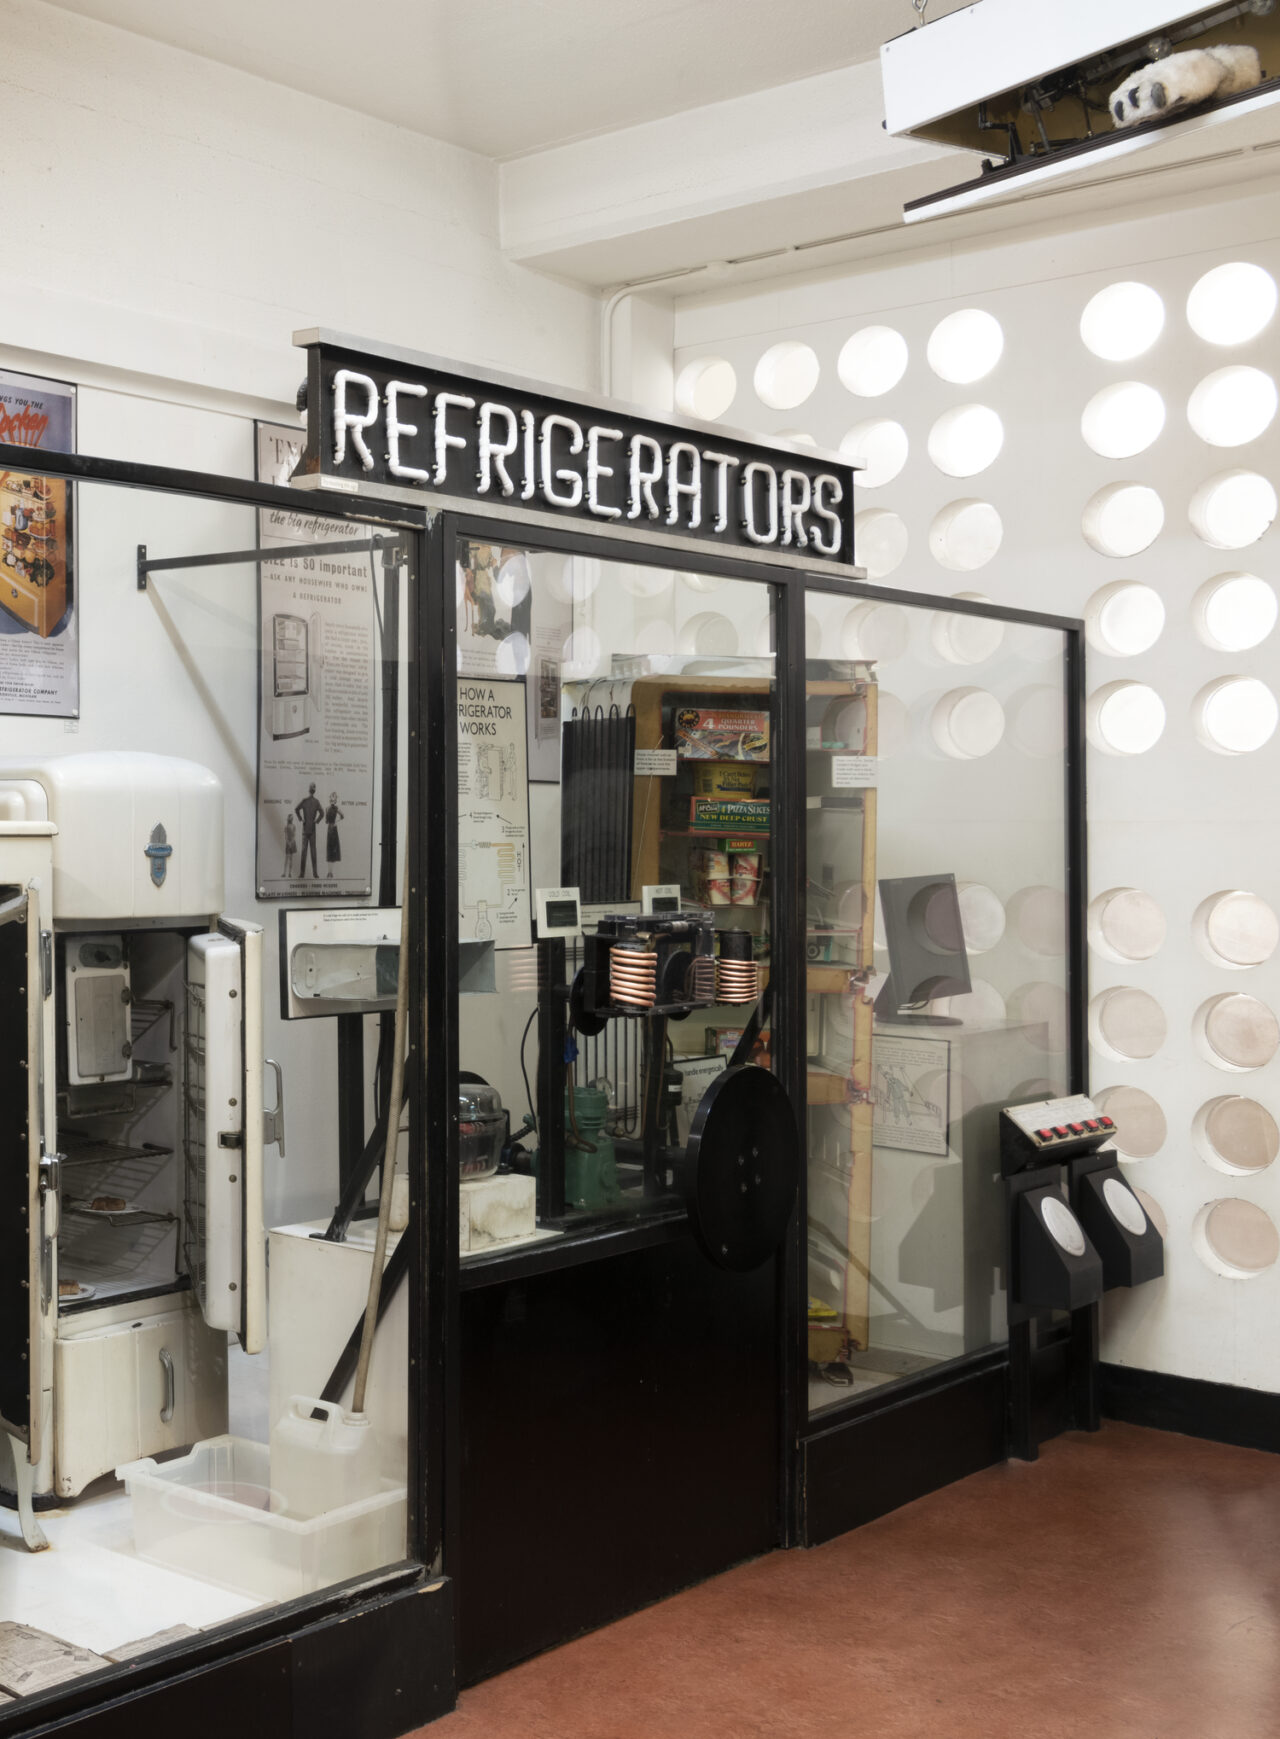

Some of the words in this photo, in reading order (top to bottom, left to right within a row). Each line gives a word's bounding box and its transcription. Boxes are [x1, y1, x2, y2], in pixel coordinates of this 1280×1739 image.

[14, 395, 30, 406] YOU
[30, 400, 44, 410] THE
[331, 368, 844, 557] REFRIGERATORS
[269, 510, 285, 526] the
[304, 516, 360, 536] refrigerator
[303, 557, 315, 571] SO
[320, 560, 368, 578] important
[300, 577, 333, 589] HOUSEWIFE
[300, 592, 342, 604] REFRIGERATOR
[33, 688, 58, 696] COMPANY
[460, 687, 486, 701] HOW
[487, 689, 495, 702] A
[457, 703, 512, 720] RIGERATOR
[460, 721, 497, 736] WORKS
[702, 718, 716, 730] 4
[727, 803, 746, 814] PIZZA
[747, 804, 770, 815] SLICES
